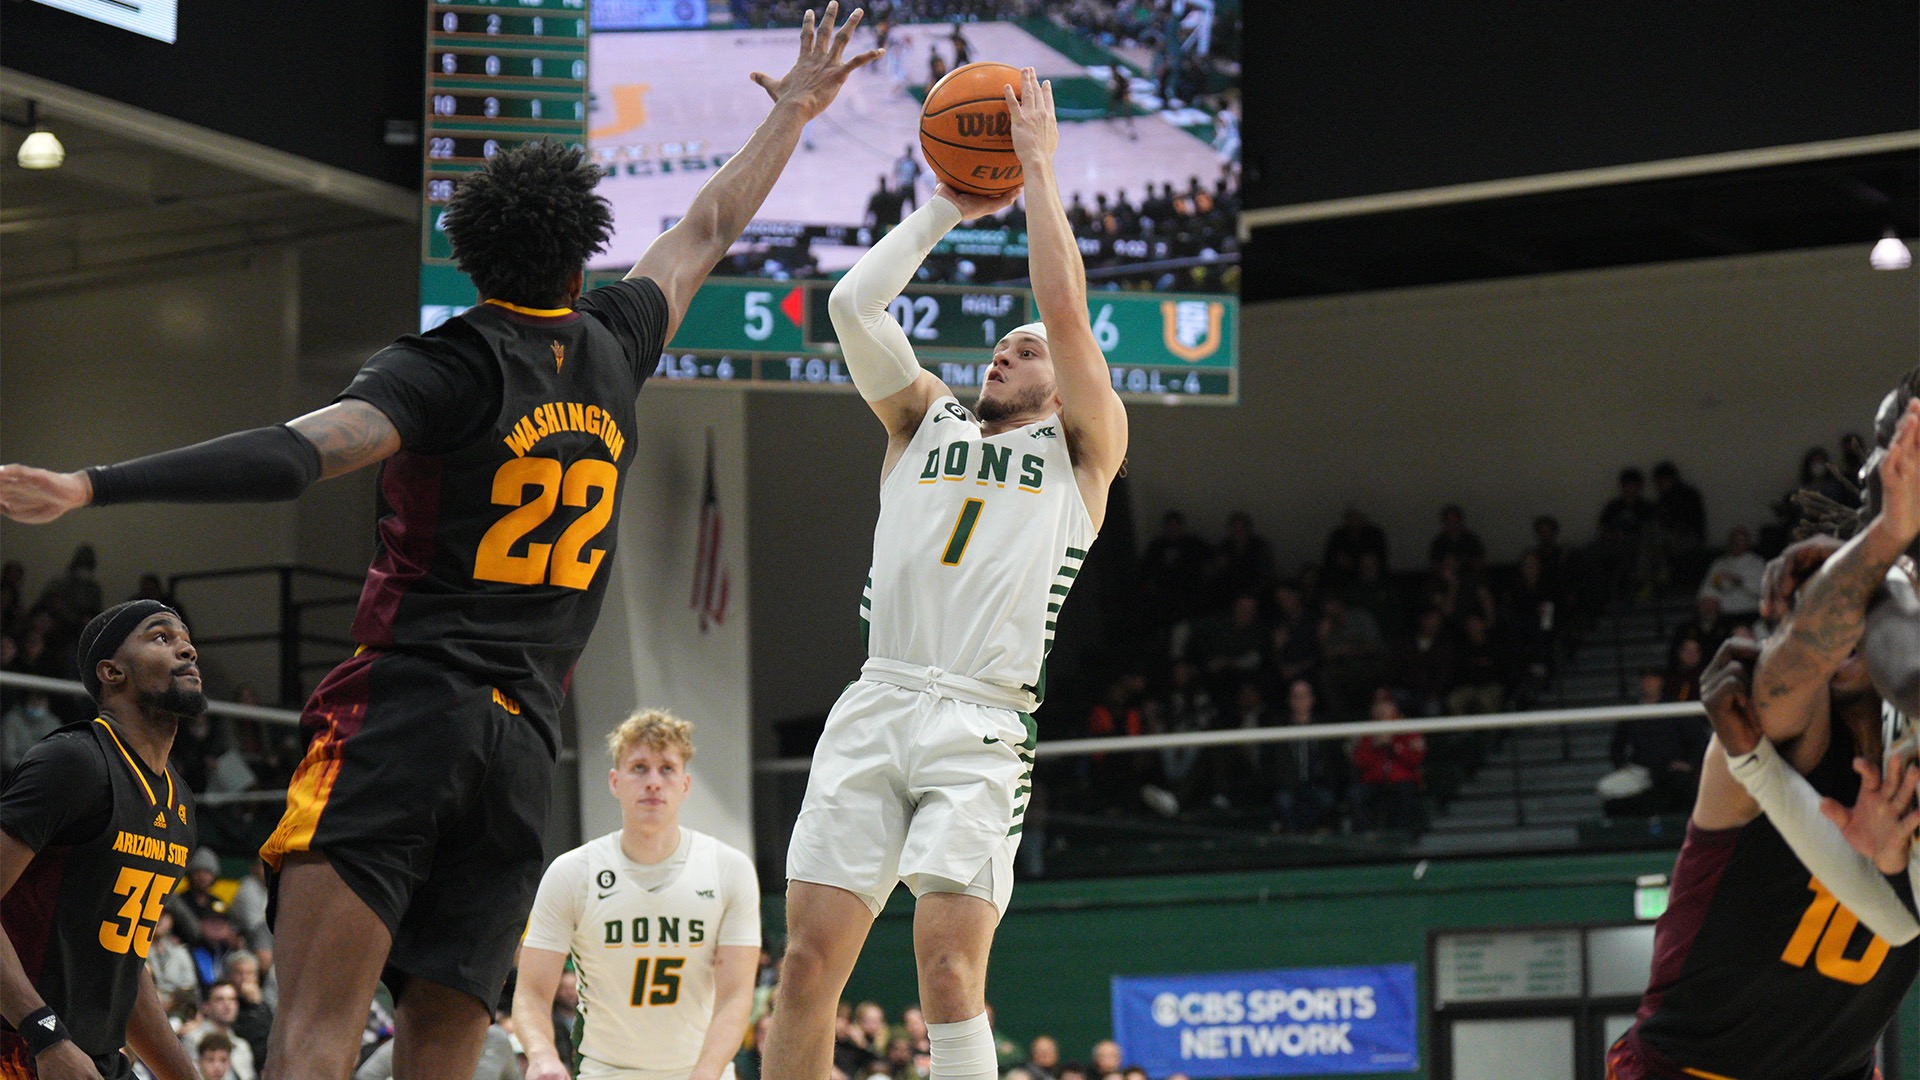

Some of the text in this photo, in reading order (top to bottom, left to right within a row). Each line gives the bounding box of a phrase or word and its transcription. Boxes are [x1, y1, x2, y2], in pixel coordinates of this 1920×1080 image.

[487, 13, 501, 35] 2
[434, 95, 456, 116] 10
[955, 111, 1012, 137] Wil
[429, 137, 455, 159] 22
[744, 291, 773, 341] 5
[888, 295, 939, 339] 02
[961, 293, 1014, 317] HALF
[983, 319, 997, 347] 1
[1090, 303, 1120, 352] 6
[503, 402, 625, 462] WASHINGTON
[918, 441, 1044, 493] DONS
[473, 457, 618, 590] 22
[941, 497, 985, 566] 1
[112, 830, 189, 868] ARIZONA STATE
[99, 866, 176, 958] 35
[604, 917, 704, 948] DONS
[1780, 875, 1891, 985] 10
[630, 957, 686, 1007] 15
[1178, 985, 1377, 1025] CBS SPORTS
[1180, 1022, 1354, 1061] NETWORK
